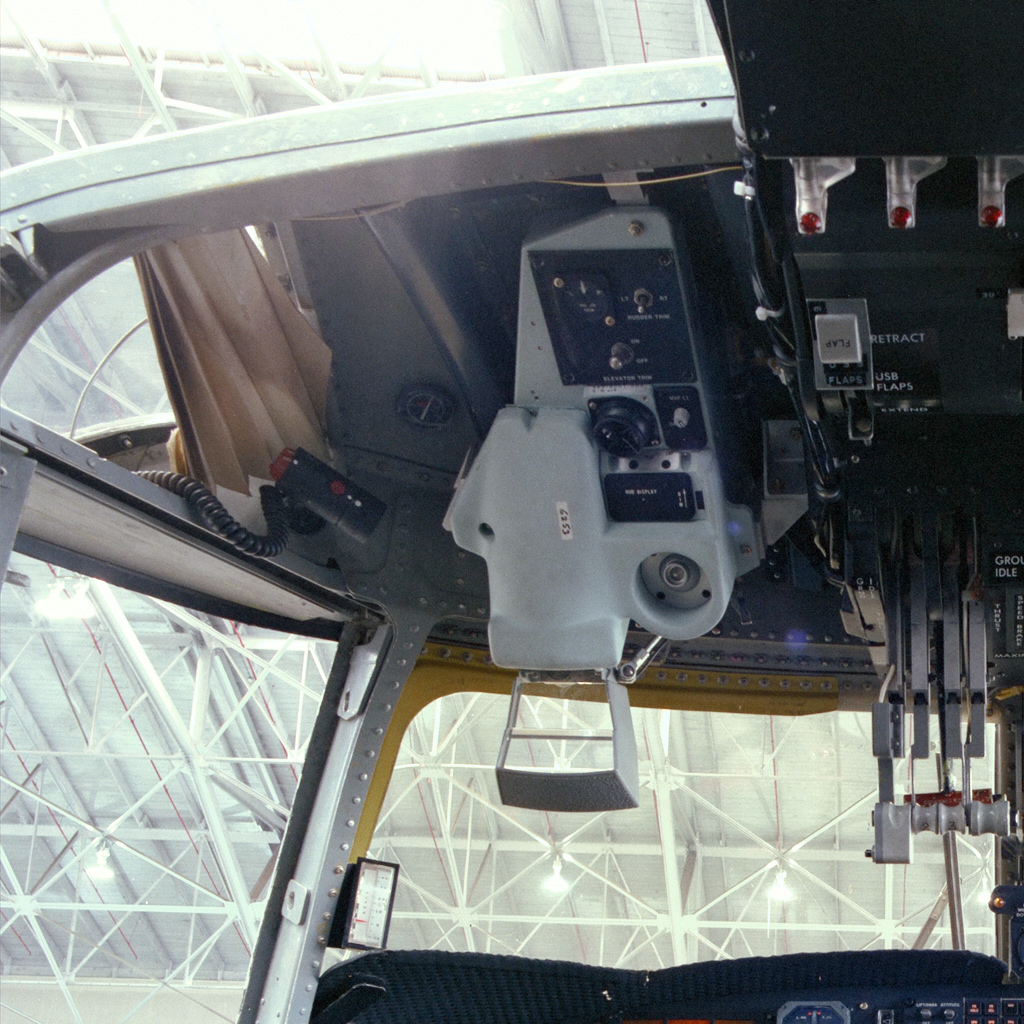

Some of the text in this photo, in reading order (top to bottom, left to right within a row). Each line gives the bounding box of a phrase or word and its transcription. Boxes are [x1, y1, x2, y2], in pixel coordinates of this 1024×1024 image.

[871, 332, 925, 344] RETRACT
[828, 376, 863, 385] FLAPS
[875, 372, 899, 382] USB
[875, 381, 914, 392] FLAPS
[994, 567, 1018, 578] IDLE
[993, 603, 1002, 633] THRUST
[1015, 595, 1024, 647] SPEED BRAKE
